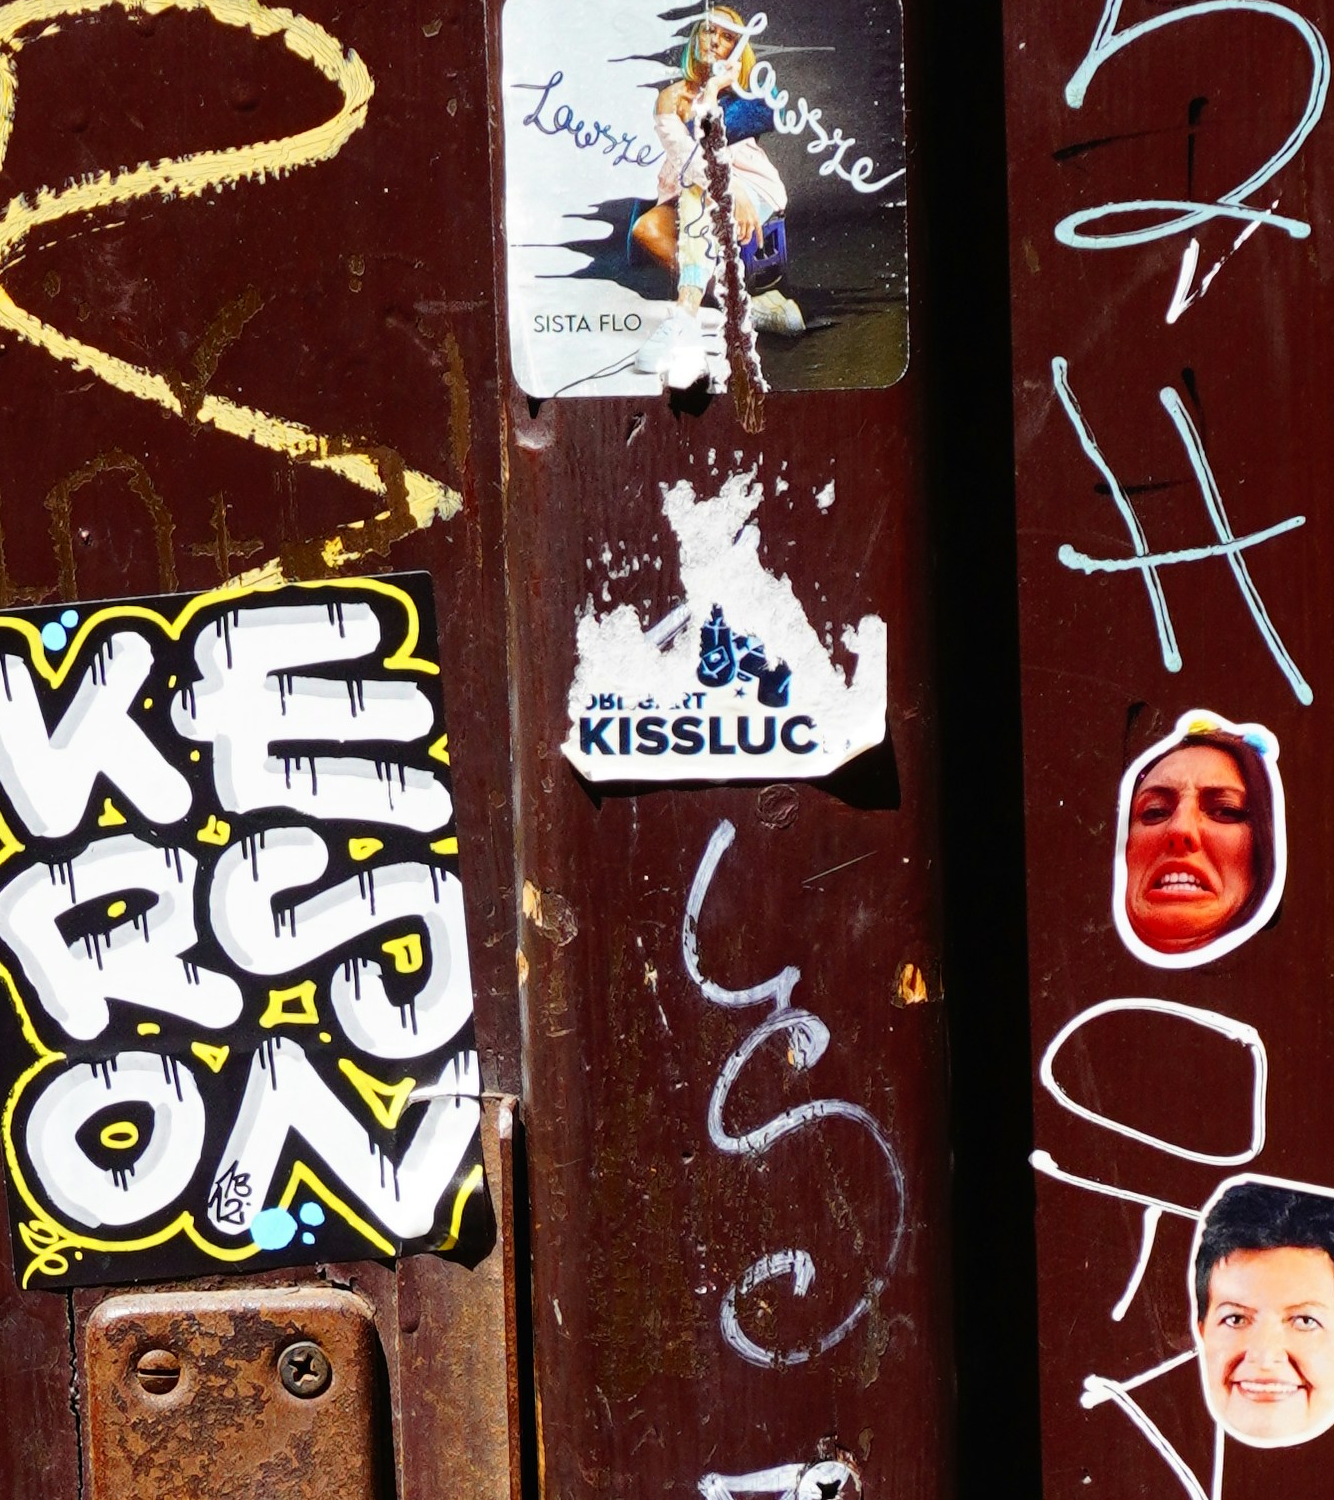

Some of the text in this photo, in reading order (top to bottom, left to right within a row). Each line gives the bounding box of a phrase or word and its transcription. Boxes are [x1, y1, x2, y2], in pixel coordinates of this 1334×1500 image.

[533, 313, 643, 334] SISTA FLO
[578, 714, 852, 756] KISSLUC
